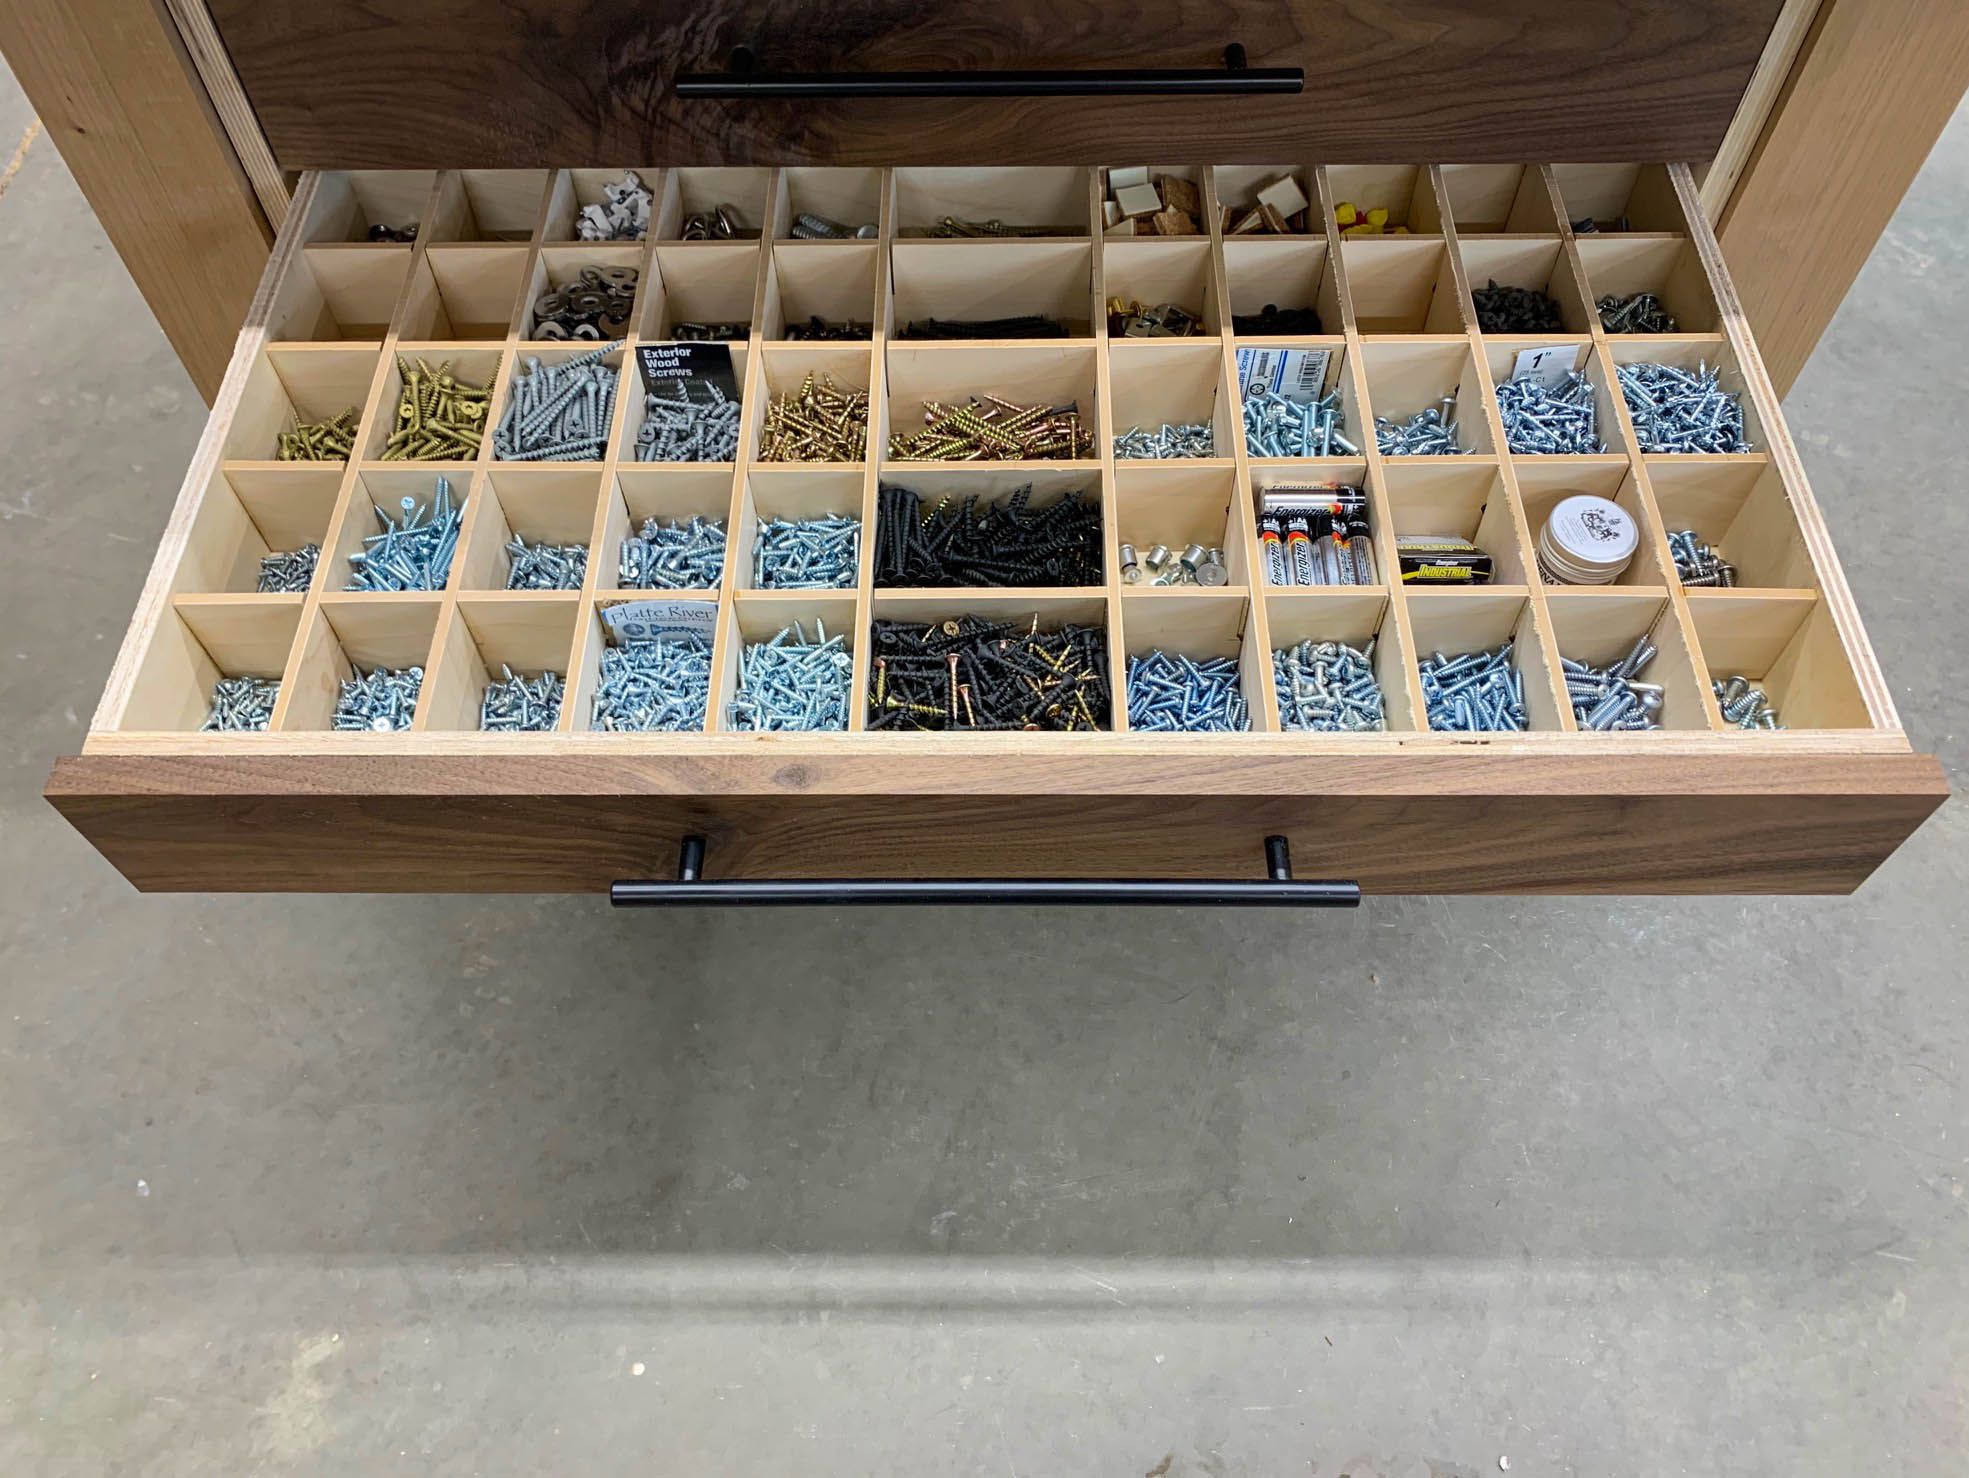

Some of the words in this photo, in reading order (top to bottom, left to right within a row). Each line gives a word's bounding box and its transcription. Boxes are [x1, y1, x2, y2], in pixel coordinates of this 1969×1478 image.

[643, 347, 692, 359] Exterior
[645, 358, 680, 368] Wood
[648, 368, 693, 378] Screws
[1274, 505, 1331, 517] Energizer
[1271, 542, 1282, 586] Energizer
[1297, 542, 1310, 586] Energizer
[610, 607, 665, 624] Platte
[668, 605, 713, 619] River
